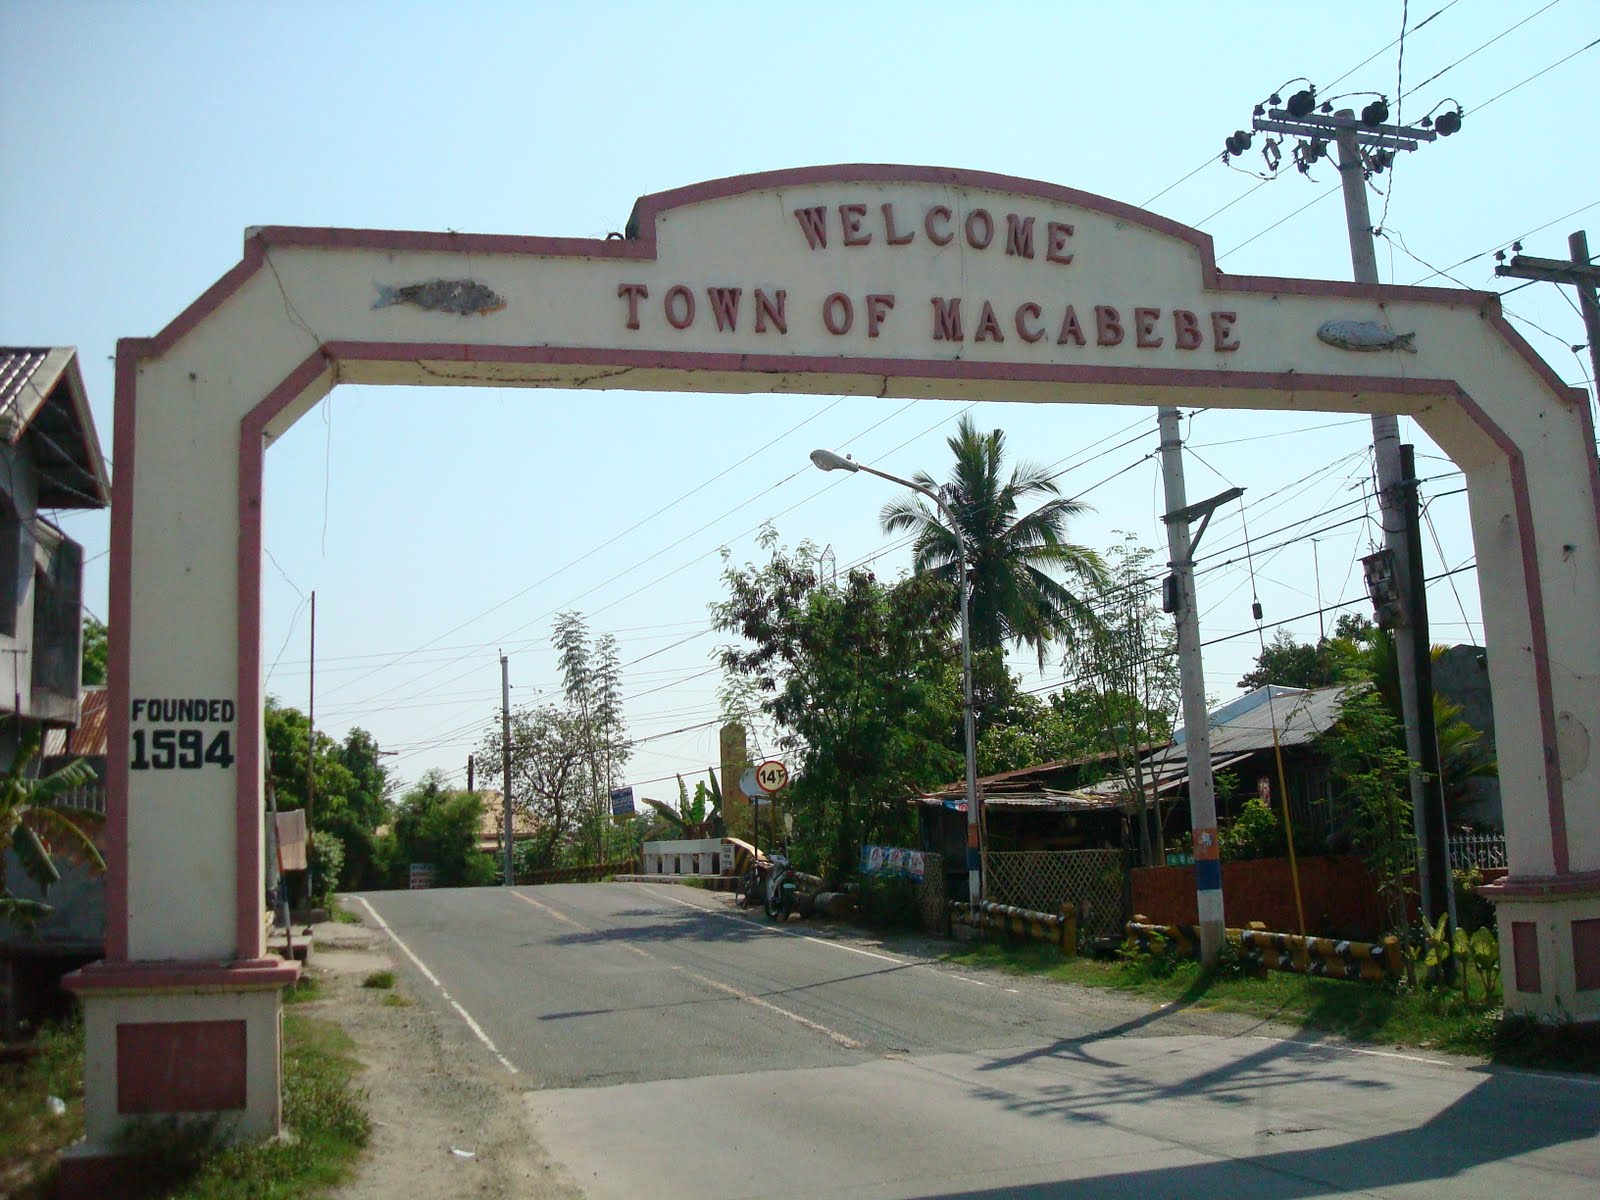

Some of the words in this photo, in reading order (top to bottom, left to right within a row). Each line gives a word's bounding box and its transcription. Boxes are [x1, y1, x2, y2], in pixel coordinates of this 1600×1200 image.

[794, 203, 1075, 265] WELCOME
[618, 284, 787, 335] TOWN
[823, 292, 895, 338] OF
[931, 297, 1240, 352] MACABEBE
[132, 699, 234, 722] FOUNDED
[131, 729, 234, 770] 1594
